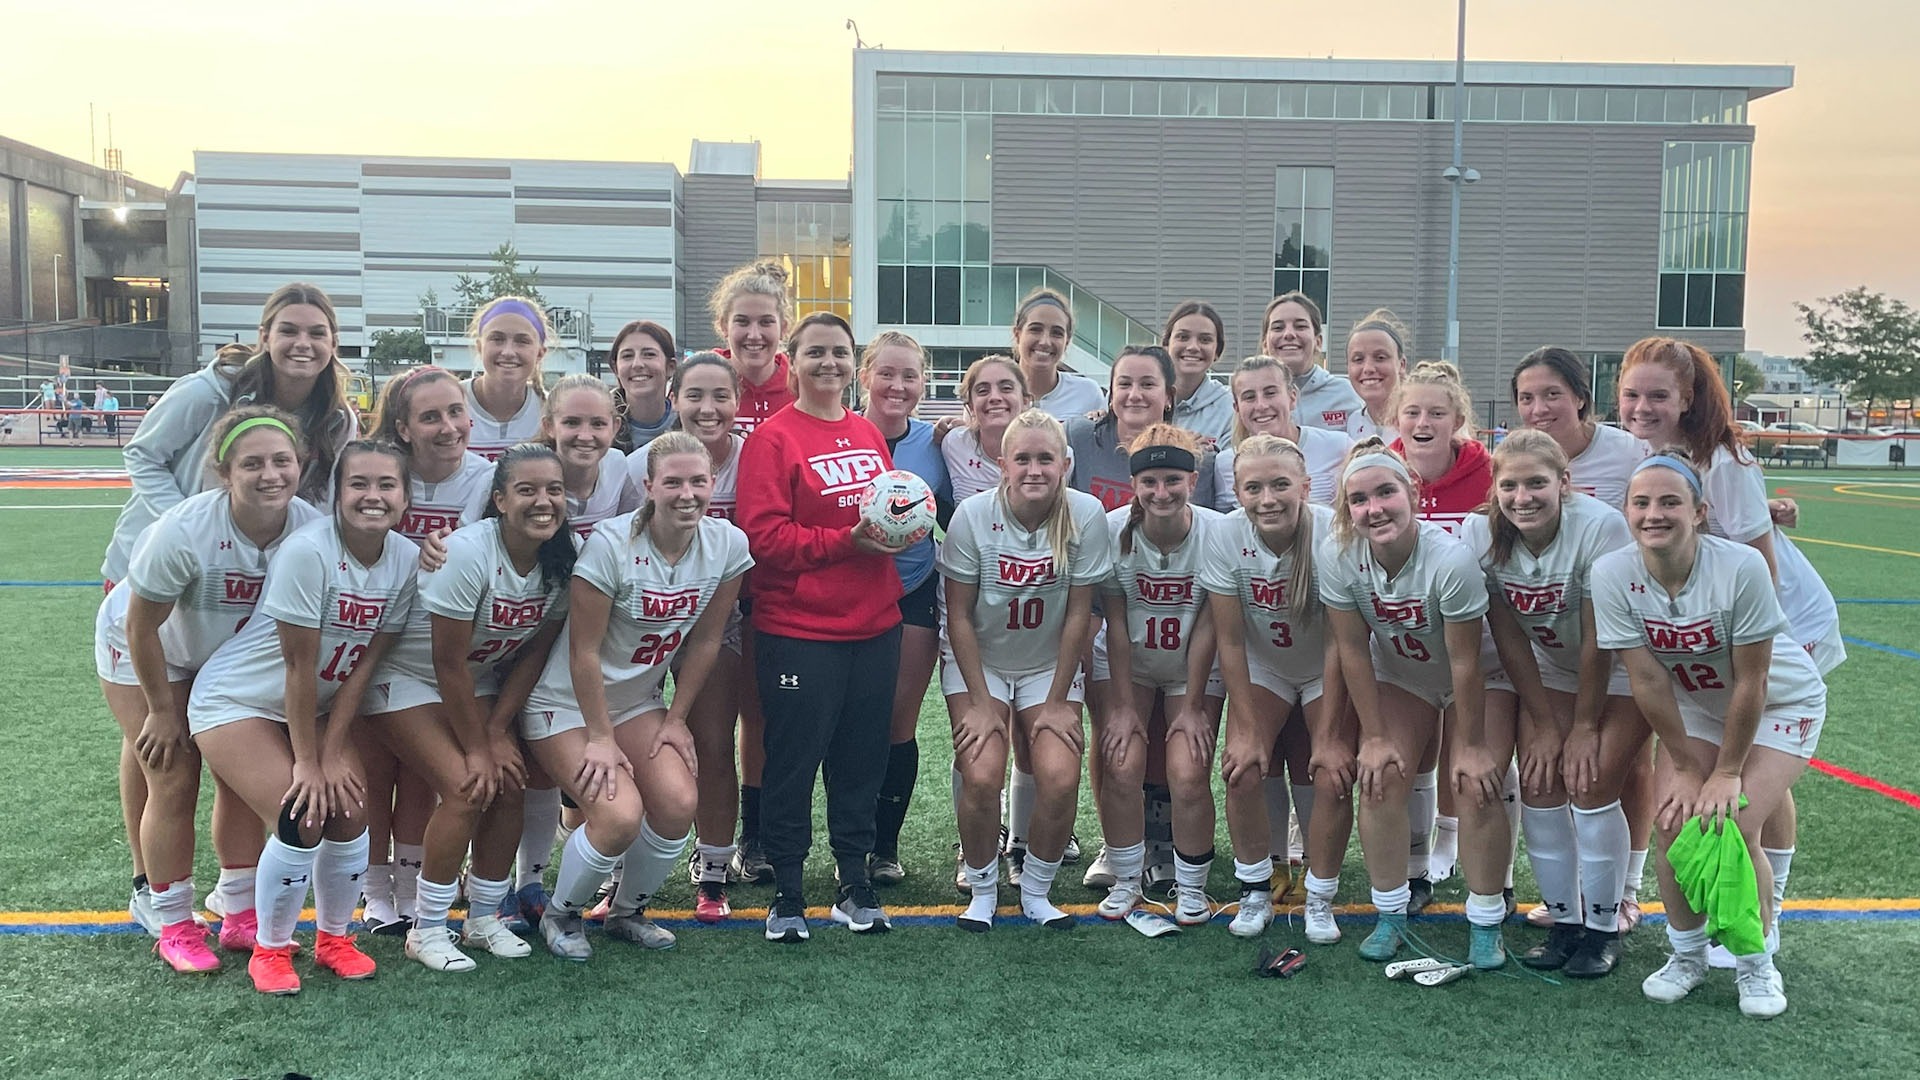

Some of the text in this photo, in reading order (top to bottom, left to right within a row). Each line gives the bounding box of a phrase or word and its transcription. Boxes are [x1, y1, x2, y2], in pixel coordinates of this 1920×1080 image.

[1322, 411, 1346, 421] WPI
[811, 454, 887, 487] WPI
[838, 493, 862, 508] SOC
[998, 559, 1057, 583] WPI
[1136, 579, 1194, 601] WPI
[1504, 588, 1567, 612] WPI
[492, 603, 546, 626] WPI
[641, 594, 700, 618] WPI
[1006, 597, 1045, 630] 10
[1144, 616, 1181, 650] 18
[1269, 621, 1293, 648] 3
[1531, 625, 1565, 649] 2
[1645, 625, 1722, 649] WPI
[1671, 663, 1725, 692] 12
